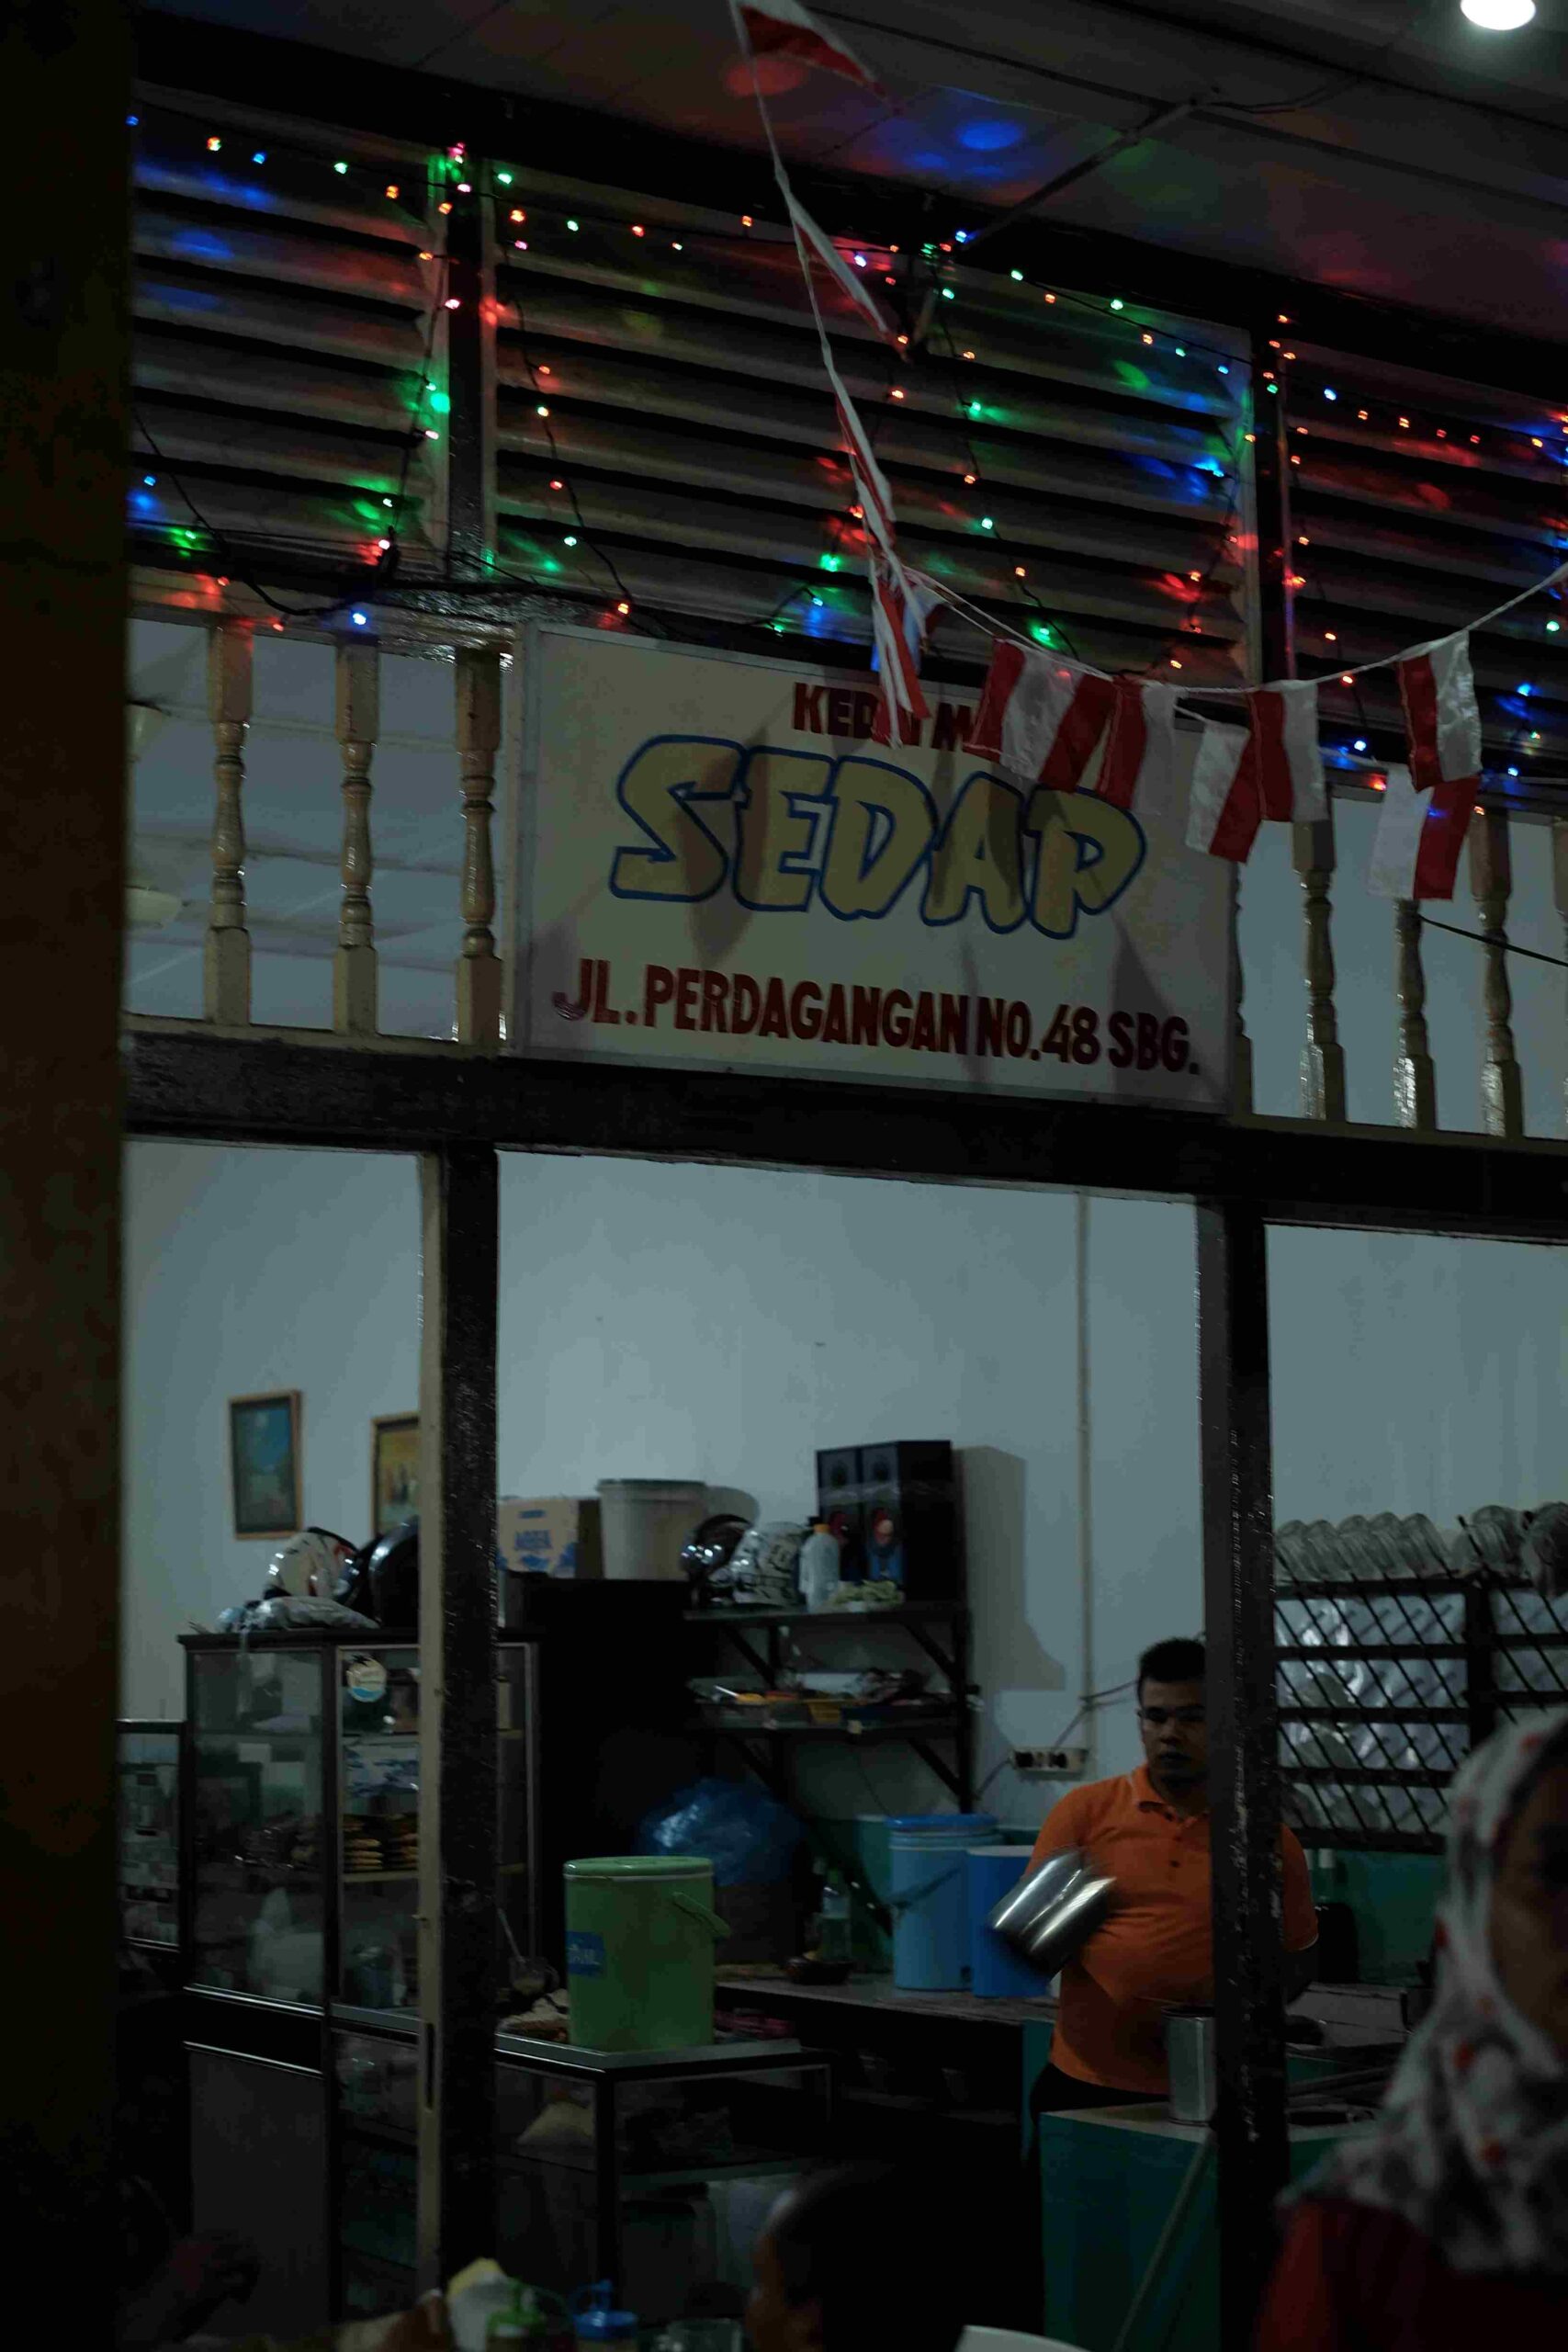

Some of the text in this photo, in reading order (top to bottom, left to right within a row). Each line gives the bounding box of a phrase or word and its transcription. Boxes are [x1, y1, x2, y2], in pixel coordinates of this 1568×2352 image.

[610, 734, 1145, 939] SEDAP
[645, 964, 970, 1056] PERDAGANGAN
[1109, 1012, 1200, 1075] SBG.
